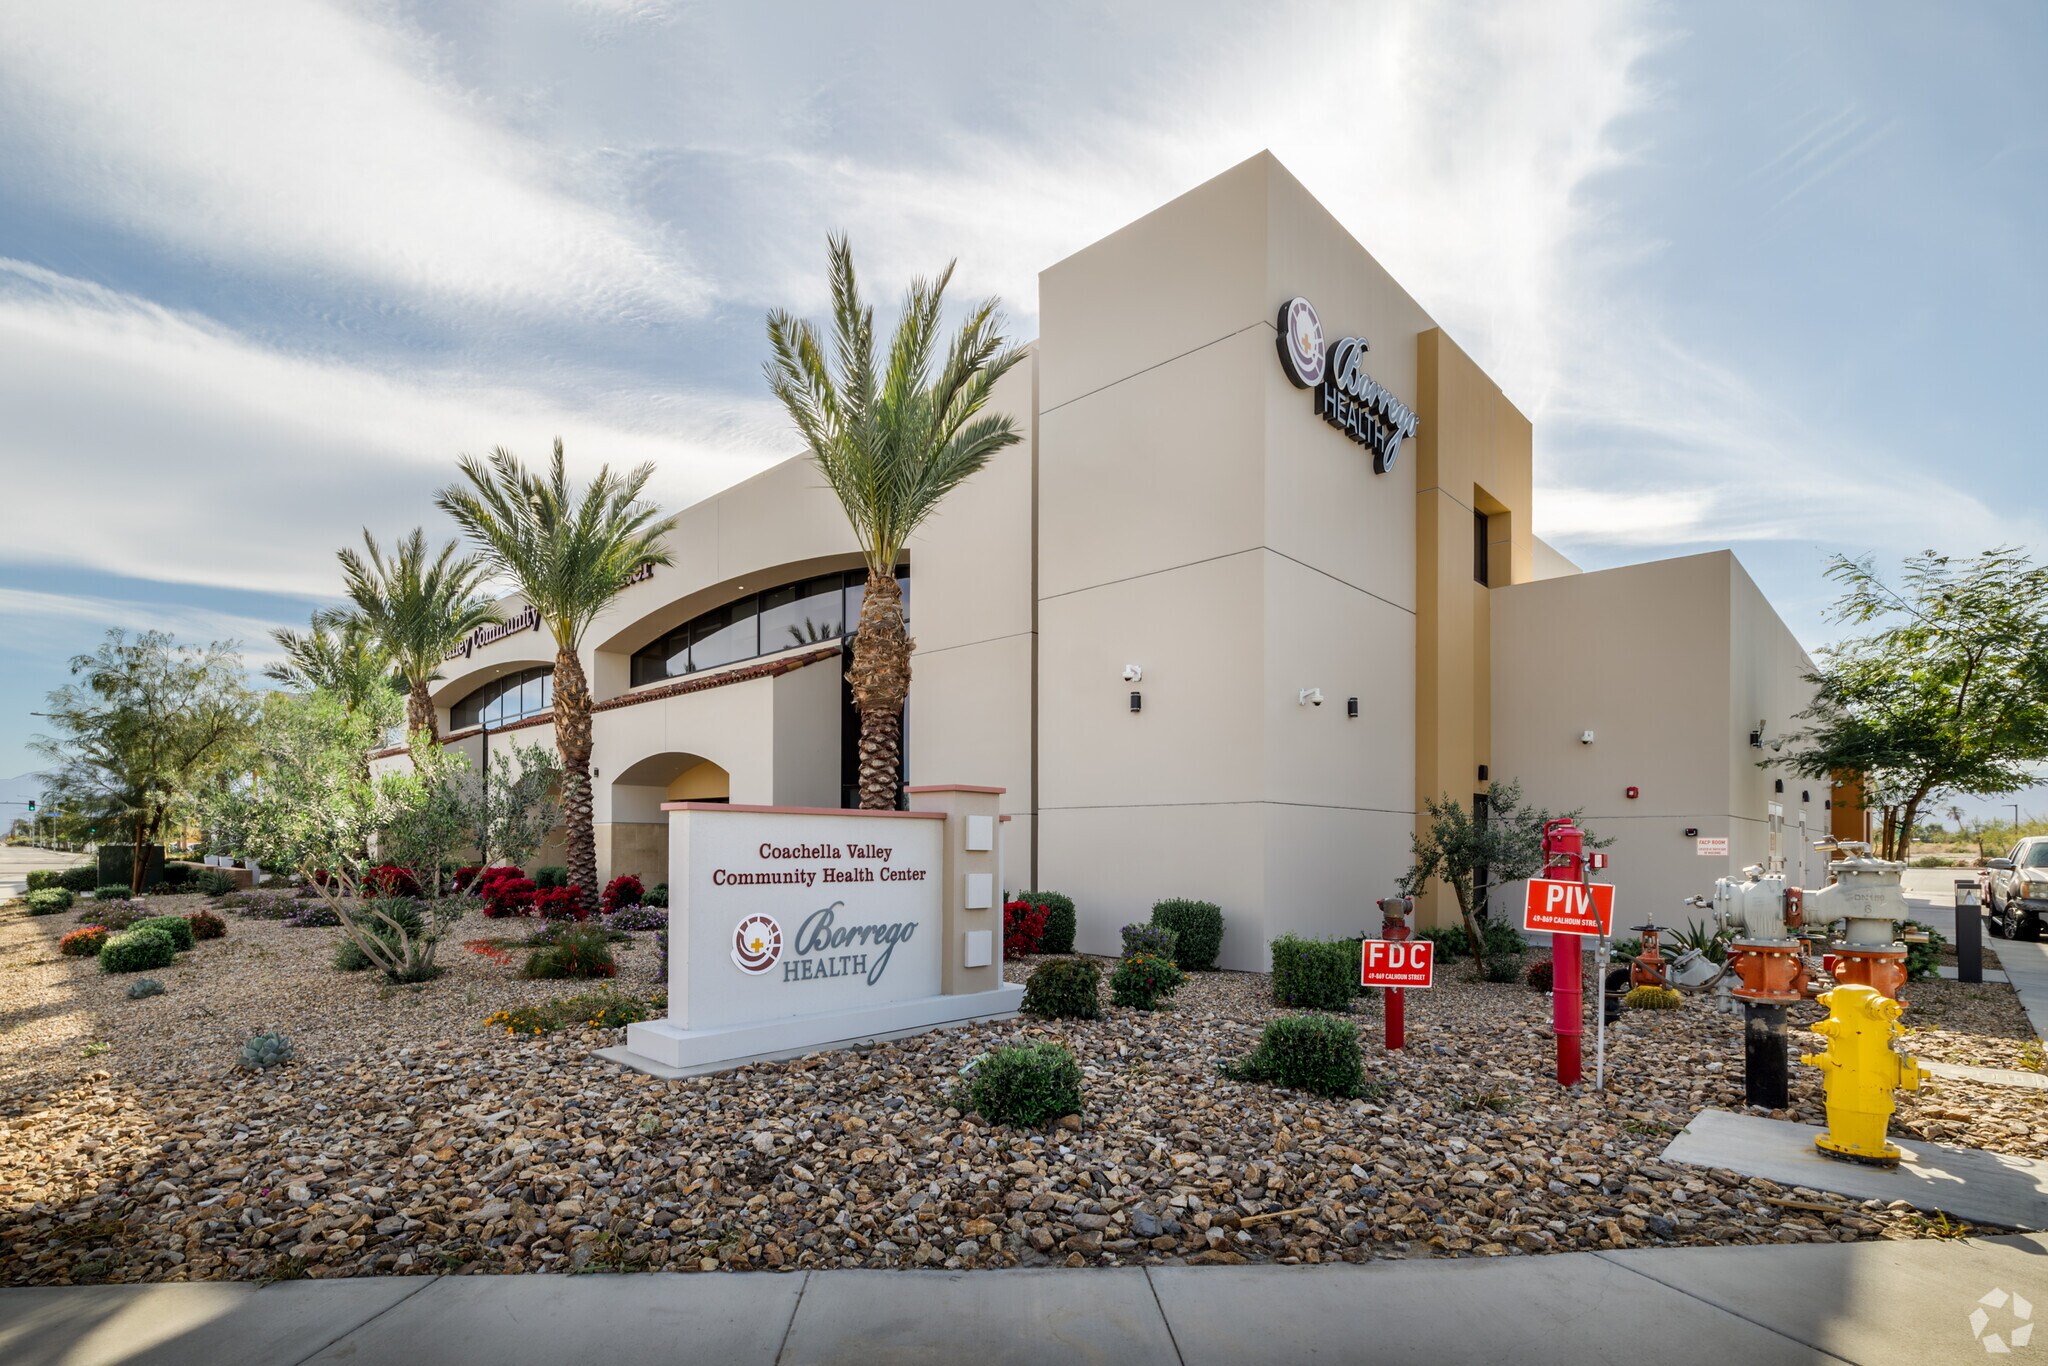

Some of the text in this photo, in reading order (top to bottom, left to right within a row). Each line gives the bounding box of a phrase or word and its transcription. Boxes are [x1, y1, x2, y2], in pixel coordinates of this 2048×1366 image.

[1324, 381, 1385, 453] HEALTH
[1332, 336, 1420, 473] Borrego
[473, 605, 539, 648] Community
[759, 843, 893, 862] Coachella Valley
[712, 867, 926, 887] Community Health Center
[1546, 884, 1593, 915] PIV
[1532, 915, 1604, 927] 49-869 CALHOUN STRET
[795, 900, 919, 986] Borrego
[1369, 943, 1426, 969] FDC
[783, 954, 867, 983] HEALTH
